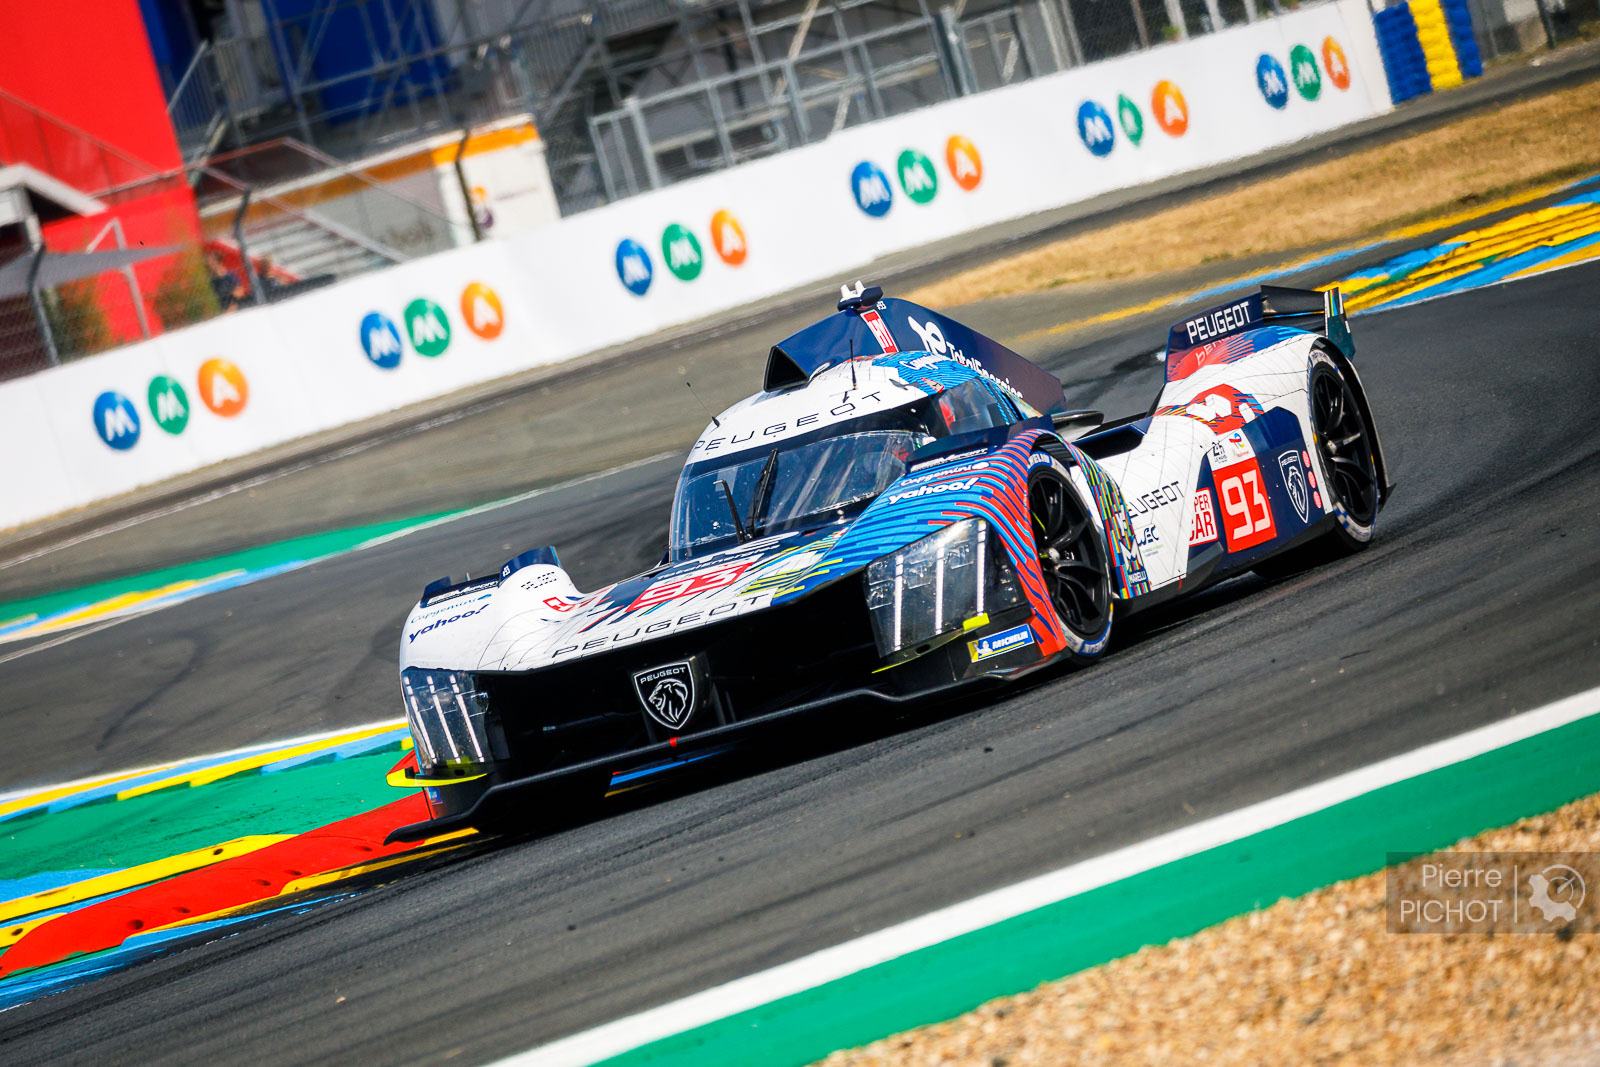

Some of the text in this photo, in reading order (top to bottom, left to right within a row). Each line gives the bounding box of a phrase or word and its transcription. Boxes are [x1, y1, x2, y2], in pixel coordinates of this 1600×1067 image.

[1186, 301, 1250, 344] PEUGEOT
[888, 477, 981, 505] yahoo!
[1127, 480, 1184, 519] EUGEOT
[1221, 469, 1271, 540] 93
[633, 566, 745, 610] 93
[409, 603, 490, 645] yahoo!
[551, 593, 769, 659] PEUGEOT
[991, 630, 1029, 650] MICHELIN
[639, 666, 687, 684] PEUGEOT
